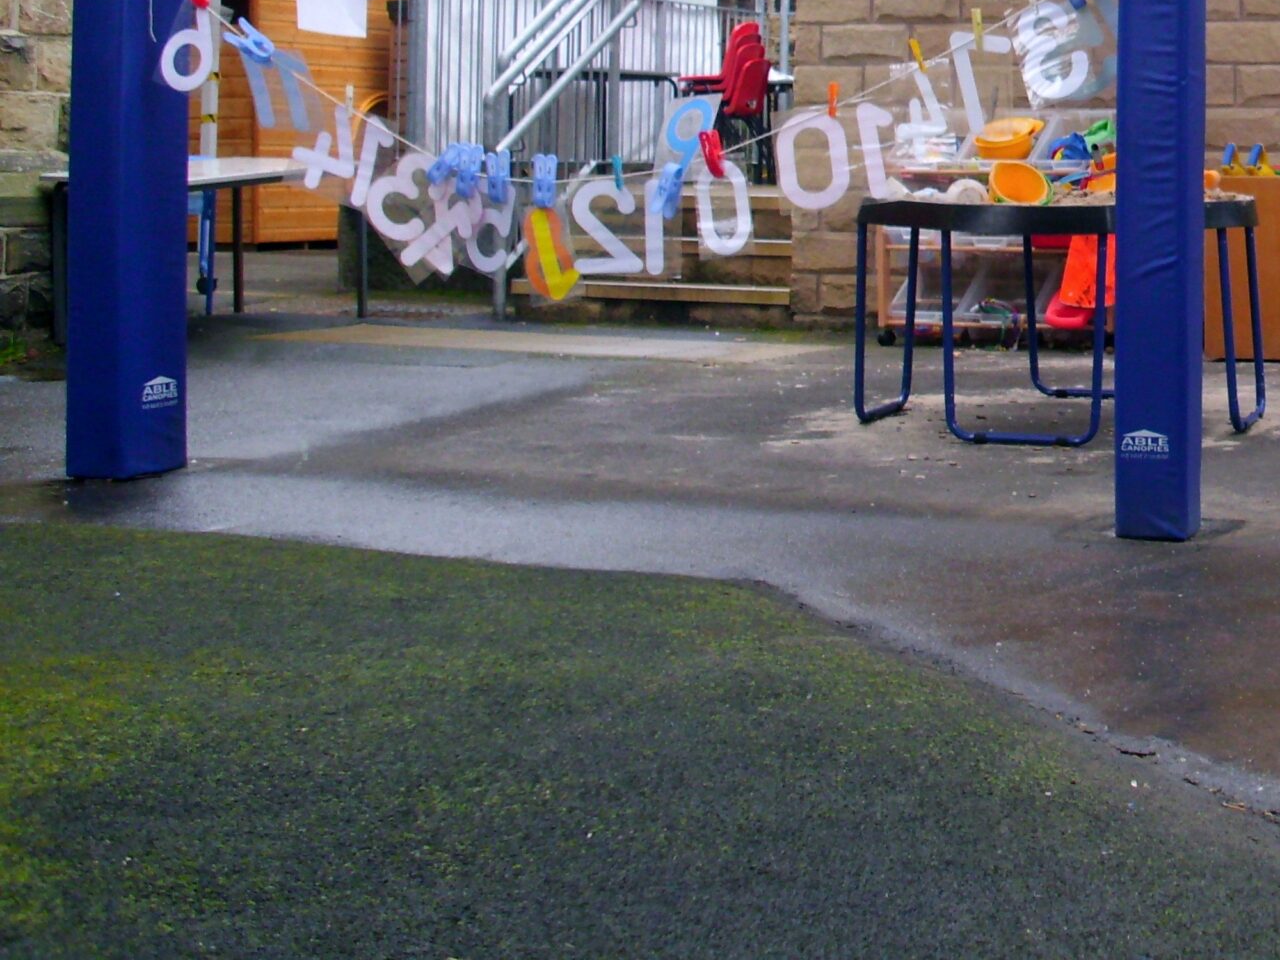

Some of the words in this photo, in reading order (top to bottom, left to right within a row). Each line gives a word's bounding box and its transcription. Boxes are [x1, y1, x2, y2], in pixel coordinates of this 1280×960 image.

[143, 383, 178, 394] ABLE
[142, 391, 178, 402] CANOPIES
[1122, 437, 1168, 446] ABLE
